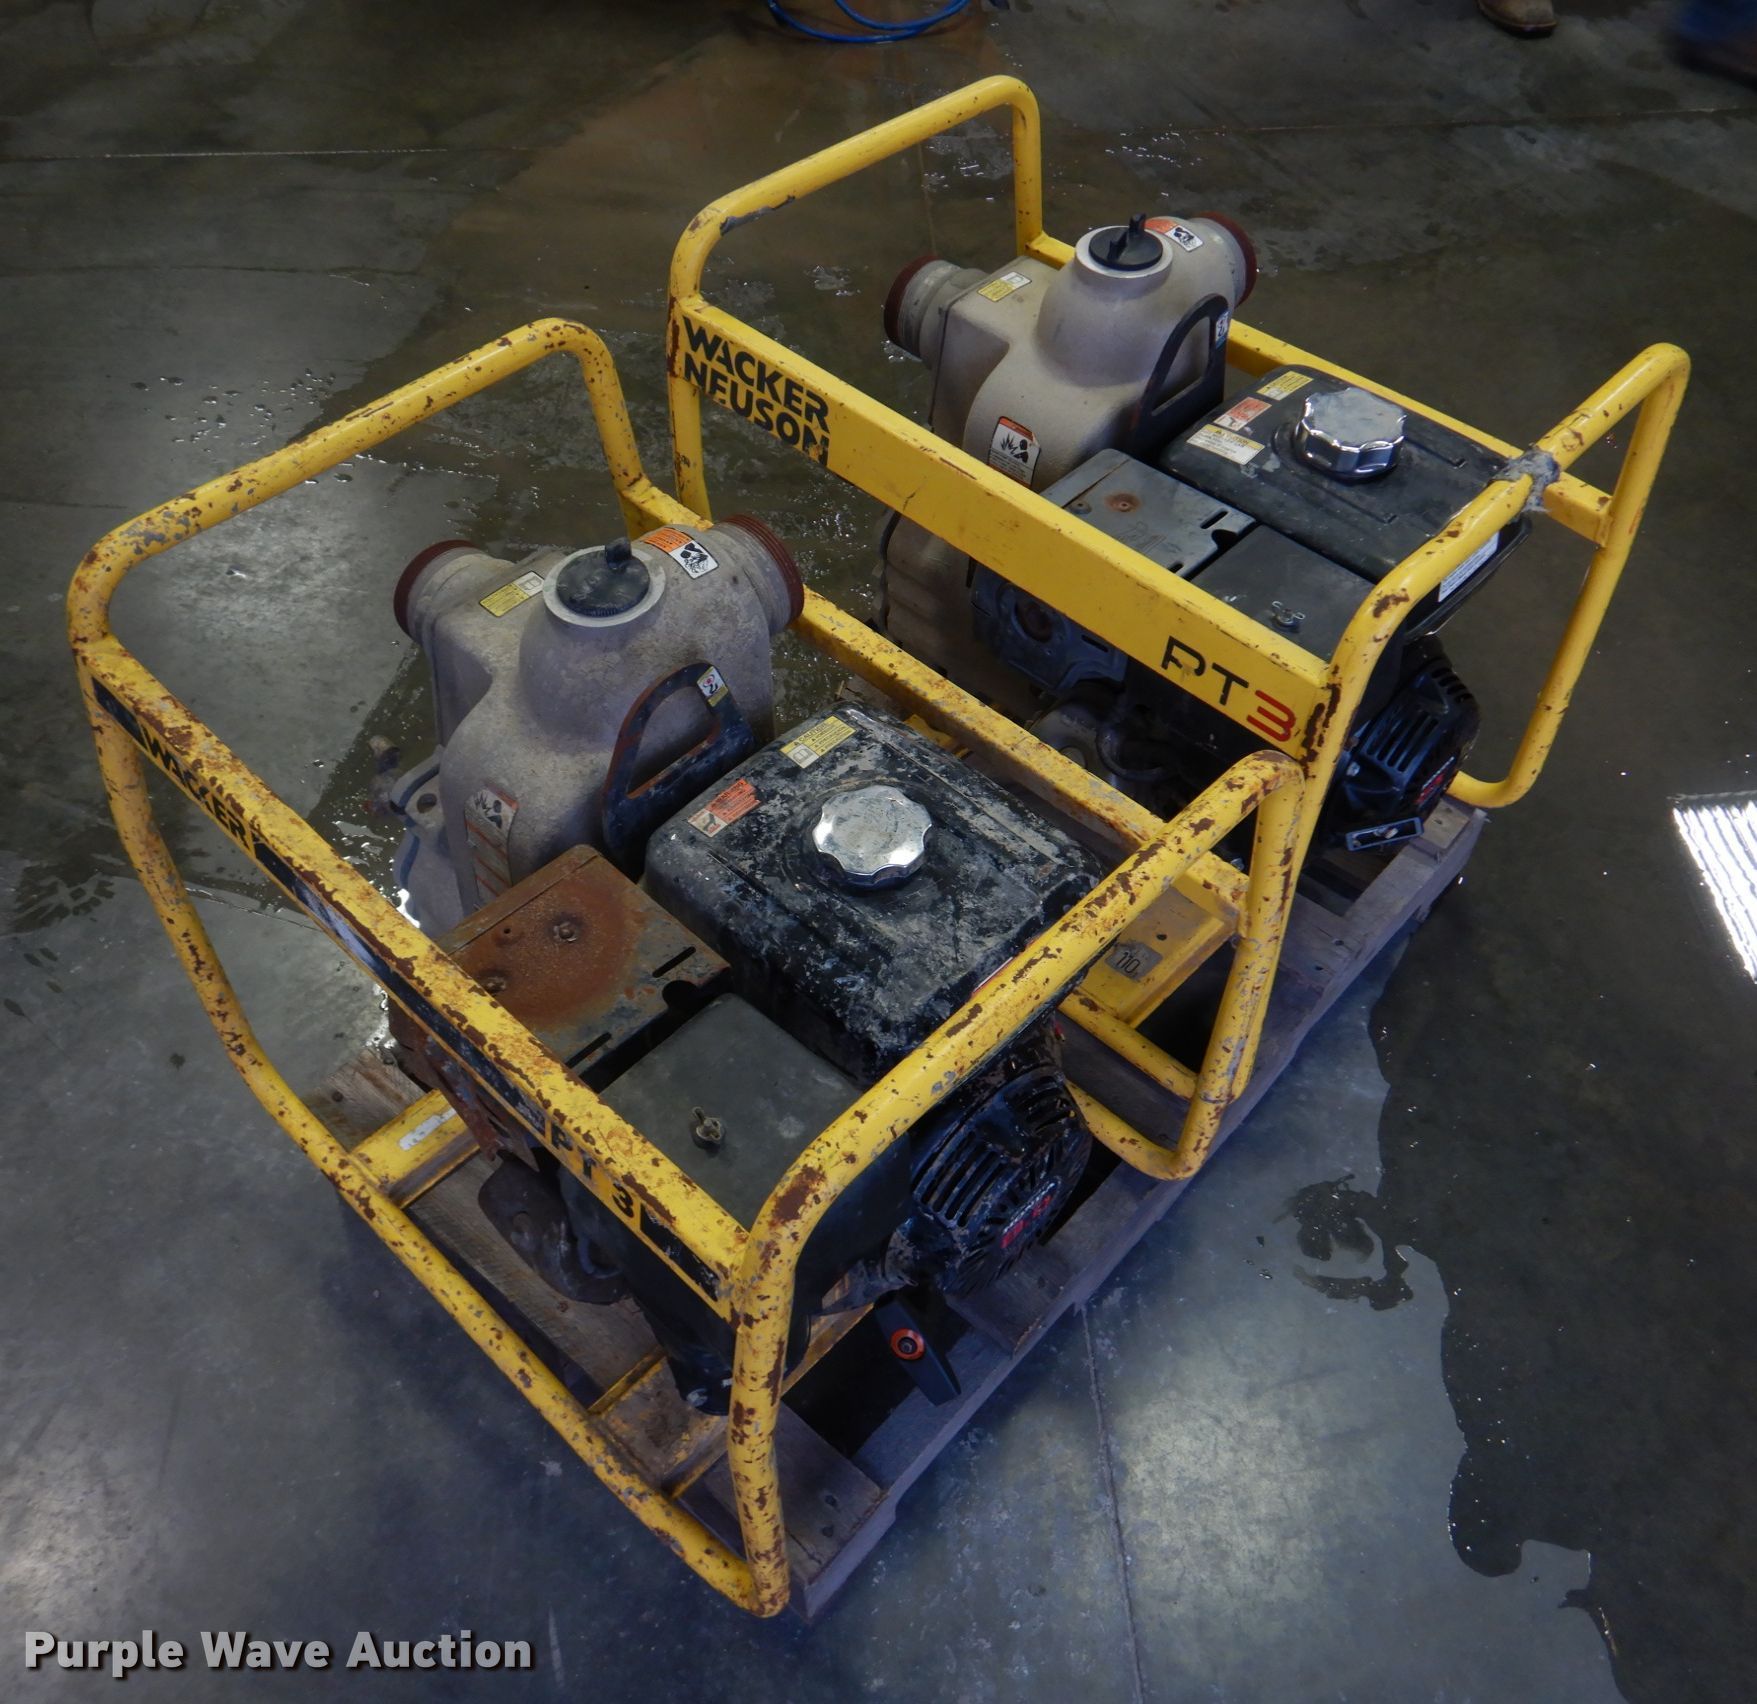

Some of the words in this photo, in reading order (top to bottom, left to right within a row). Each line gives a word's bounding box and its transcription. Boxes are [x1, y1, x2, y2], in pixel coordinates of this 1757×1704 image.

[683, 315, 830, 434] WACKER
[684, 353, 830, 468] NEUSON
[1161, 635, 1297, 743] PT3
